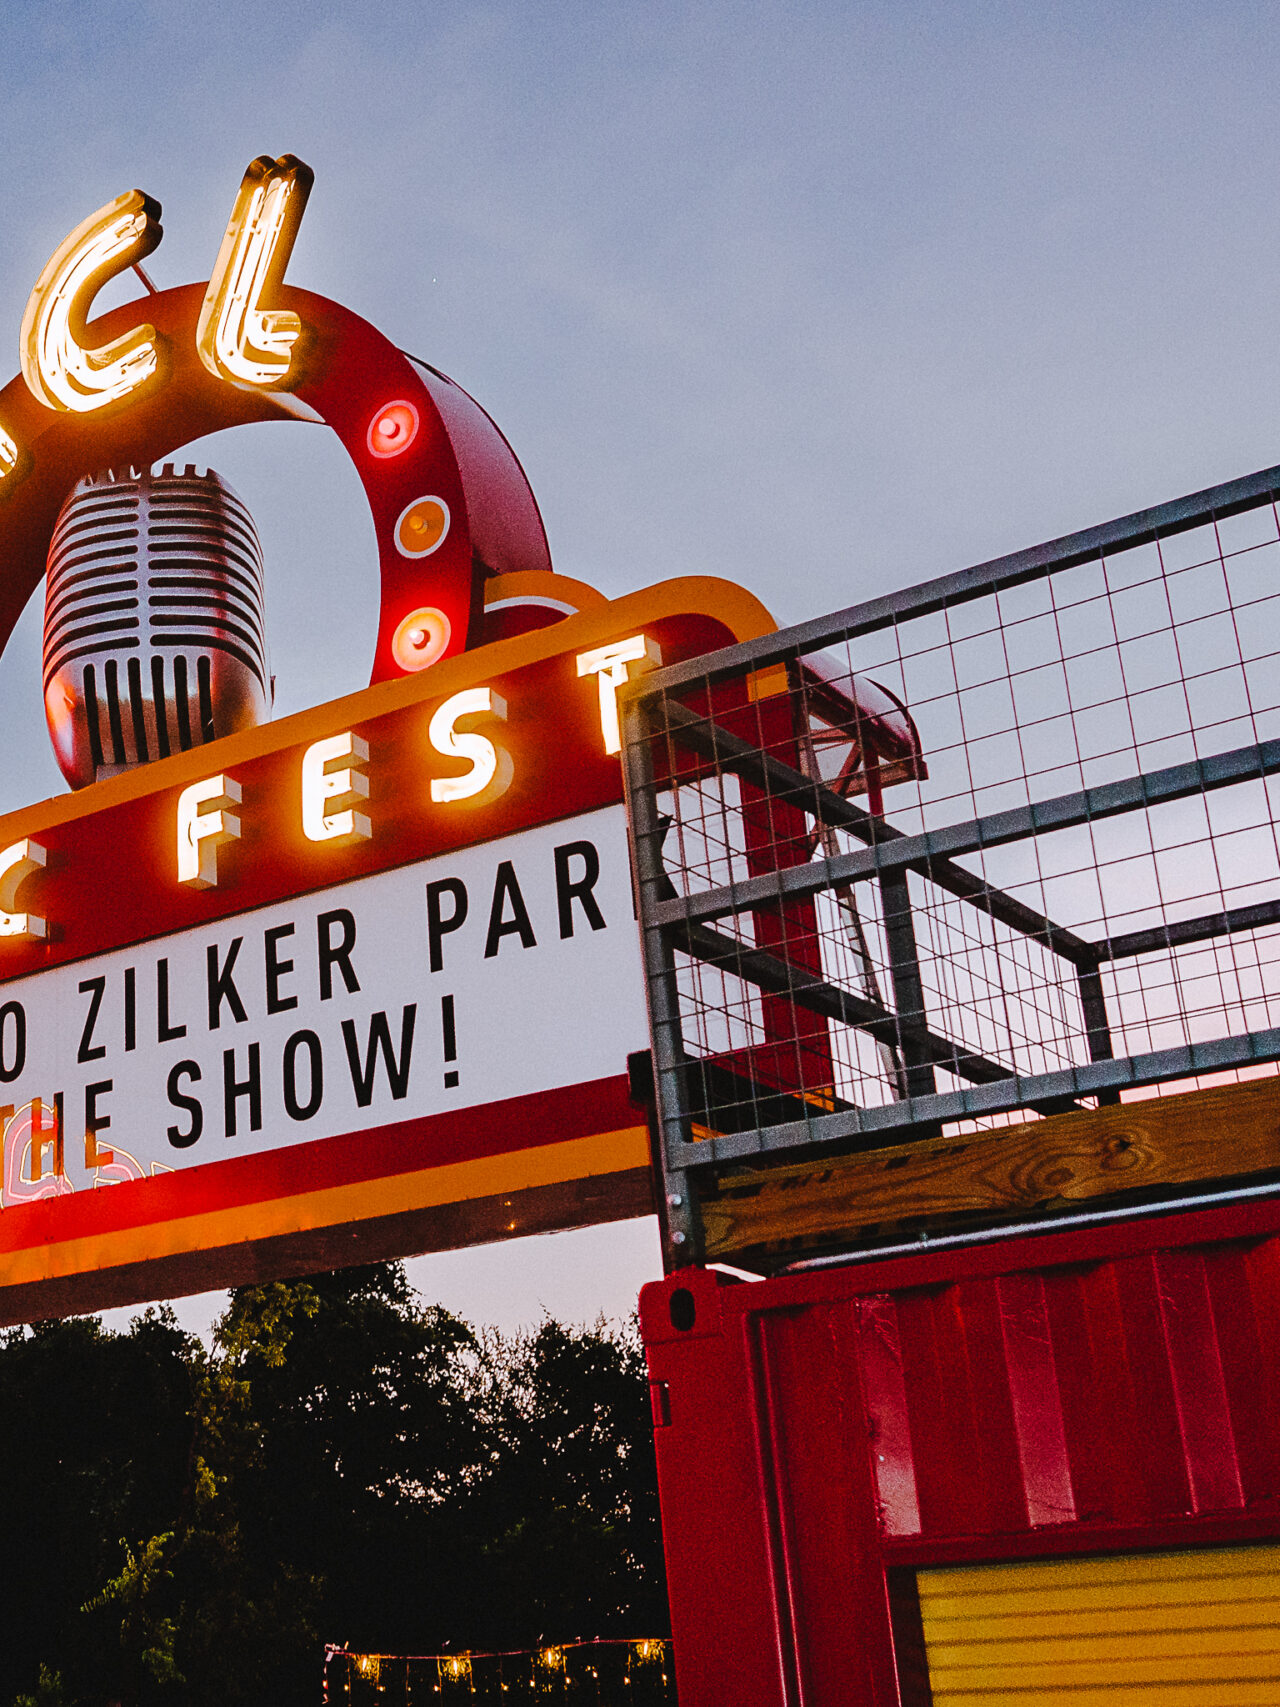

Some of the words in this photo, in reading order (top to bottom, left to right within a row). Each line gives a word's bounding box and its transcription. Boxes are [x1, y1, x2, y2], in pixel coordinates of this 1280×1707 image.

[176, 634, 661, 889] FEST
[76, 908, 361, 1064] ZILKER
[166, 995, 460, 1148] SHOW!
